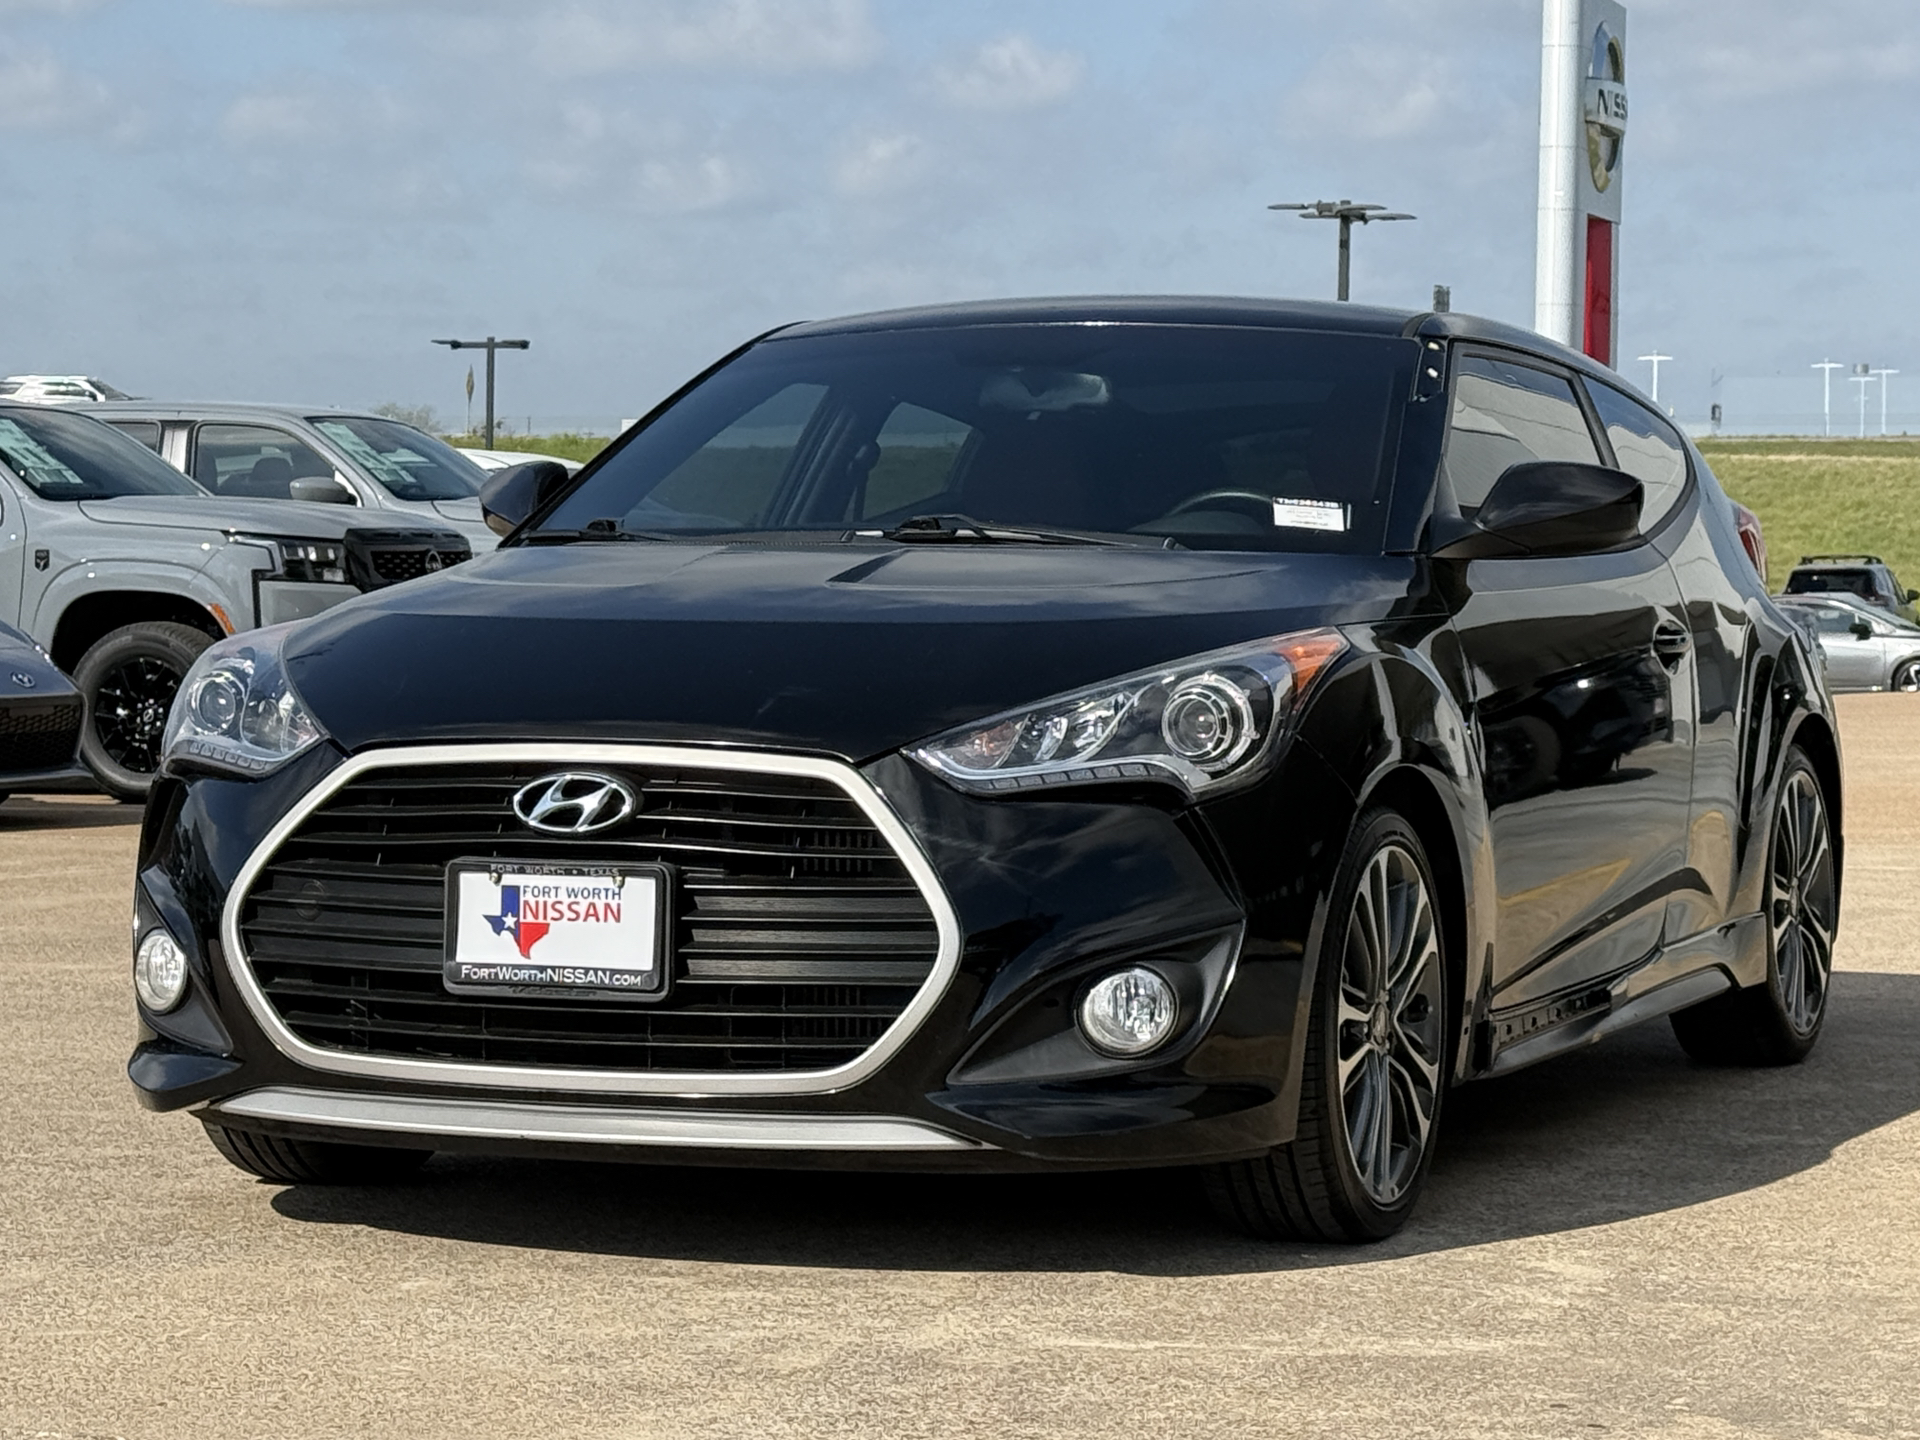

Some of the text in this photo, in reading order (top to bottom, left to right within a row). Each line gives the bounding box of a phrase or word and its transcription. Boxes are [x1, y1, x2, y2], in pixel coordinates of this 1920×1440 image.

[1597, 88, 1628, 120] NISS
[583, 867, 620, 877] TEXAS
[523, 885, 621, 901] FORT WORTH
[523, 900, 621, 923] NISSAN
